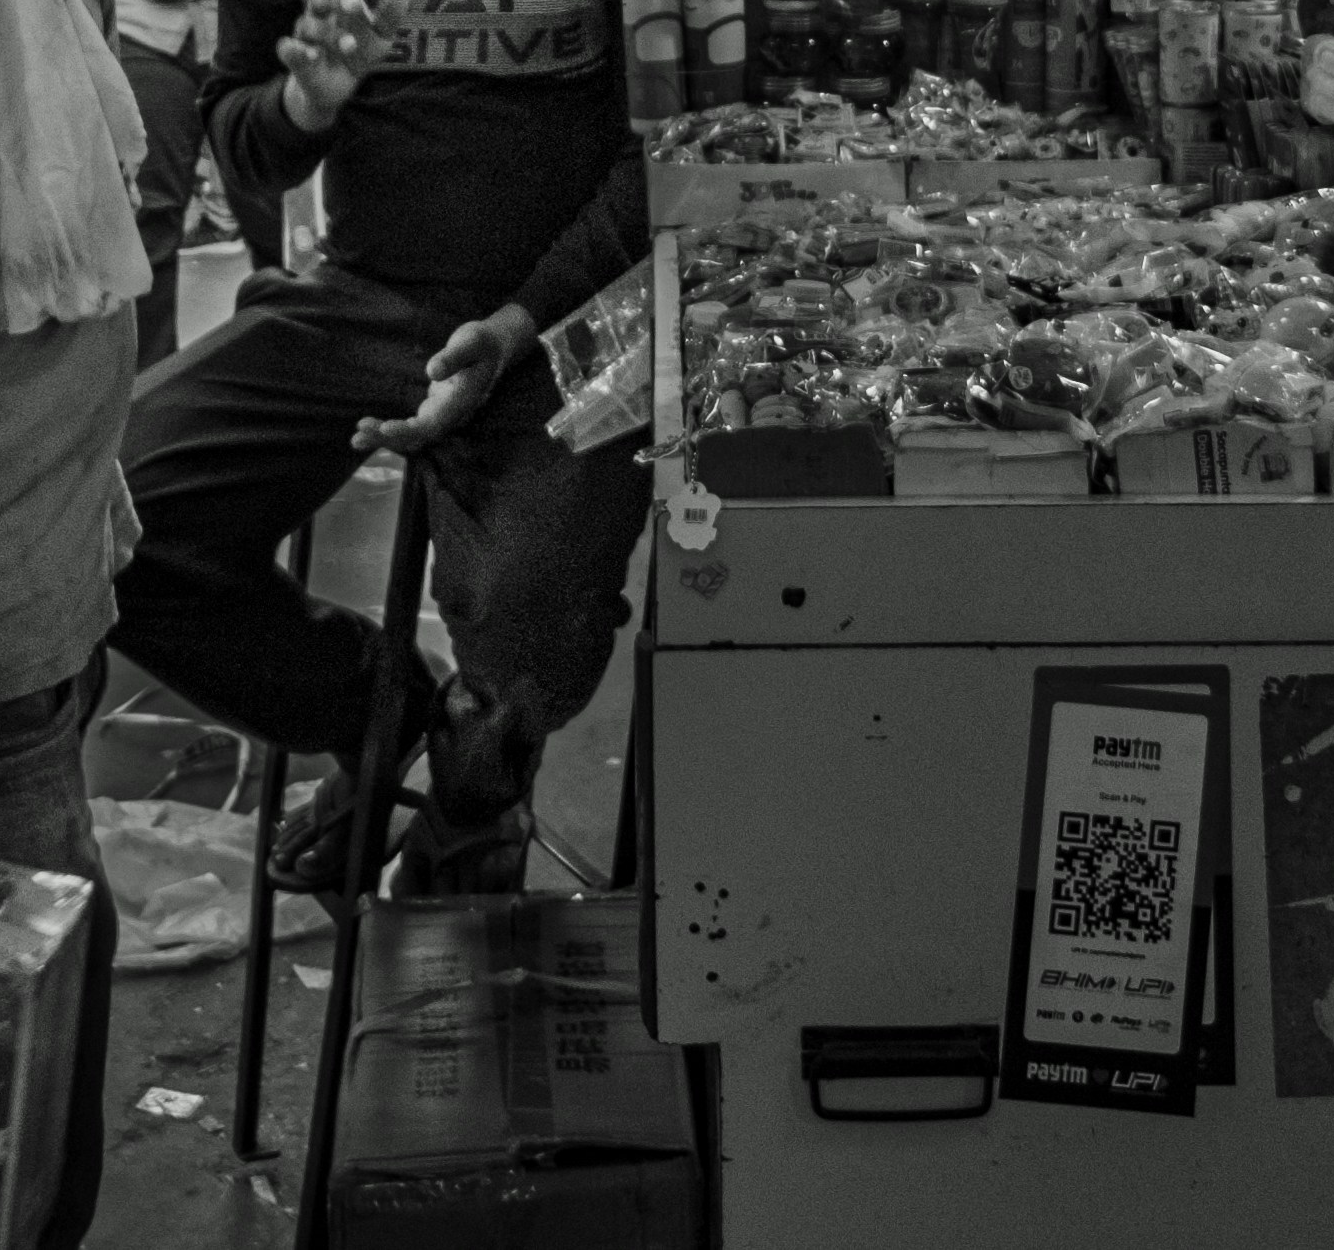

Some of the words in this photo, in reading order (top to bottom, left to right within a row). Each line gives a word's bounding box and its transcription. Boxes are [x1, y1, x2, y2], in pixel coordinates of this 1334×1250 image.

[1197, 434, 1211, 476] Double
[1092, 756, 1136, 771] Accepted
[1138, 761, 1161, 772] Here
[1099, 791, 1121, 802] Scan
[1130, 795, 1147, 806] Pay
[1040, 969, 1107, 990] BHIM
[1125, 976, 1165, 995] UPI
[1111, 1069, 1159, 1091] UPI
